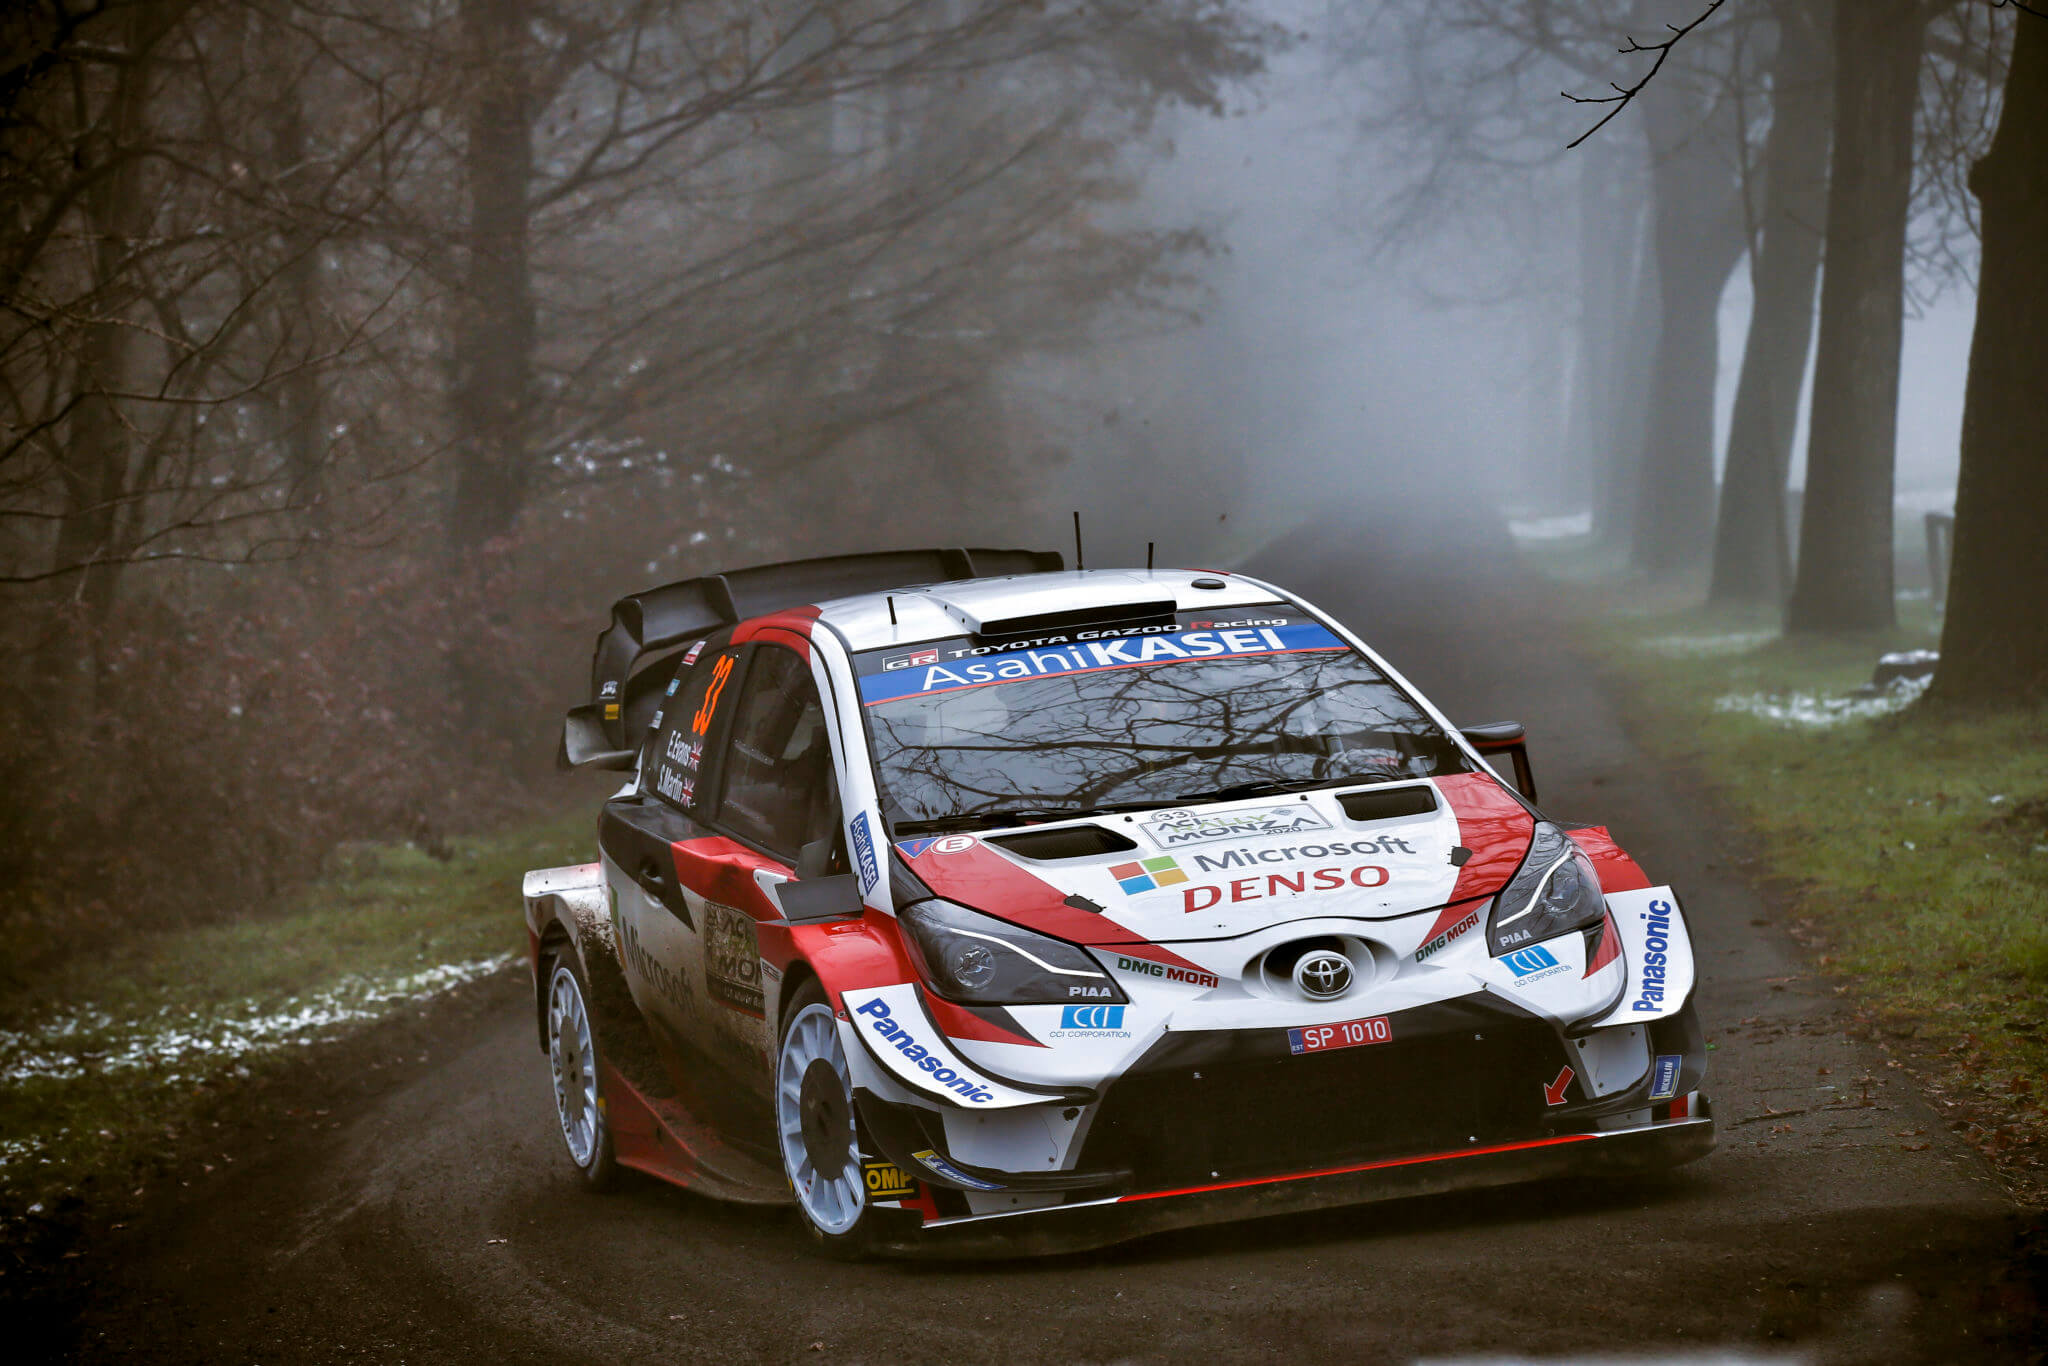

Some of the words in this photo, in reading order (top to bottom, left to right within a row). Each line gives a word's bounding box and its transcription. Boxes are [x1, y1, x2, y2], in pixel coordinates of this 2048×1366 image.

[886, 652, 938, 671] GR
[949, 634, 1070, 659] TOYOTA
[1076, 624, 1182, 643] GAZOO
[1190, 616, 1288, 633] Racing
[922, 628, 1286, 691] AsahiKASEI
[691, 654, 734, 736] 33
[1158, 810, 1187, 822] 33
[1168, 817, 1320, 843] MONZA
[1264, 827, 1302, 836] 2020
[852, 817, 877, 892] AsahiKASEI
[1193, 835, 1416, 872] Microsoft
[1182, 865, 1390, 913] DENSO
[1415, 936, 1446, 963] DMG
[1446, 912, 1480, 943] MORI
[1500, 929, 1532, 947] PIAA
[1118, 956, 1163, 977] DMG
[1166, 968, 1219, 989] MORI
[1632, 899, 1671, 1012] Panasonic
[1069, 986, 1112, 998] PIAA
[856, 997, 994, 1104] Panasonic
[1049, 1031, 1065, 1039] CCI
[1067, 1031, 1131, 1039] CORPORATION
[1305, 1027, 1334, 1048] SP
[1341, 1020, 1386, 1043] 1010
[866, 1168, 912, 1190] OMP
